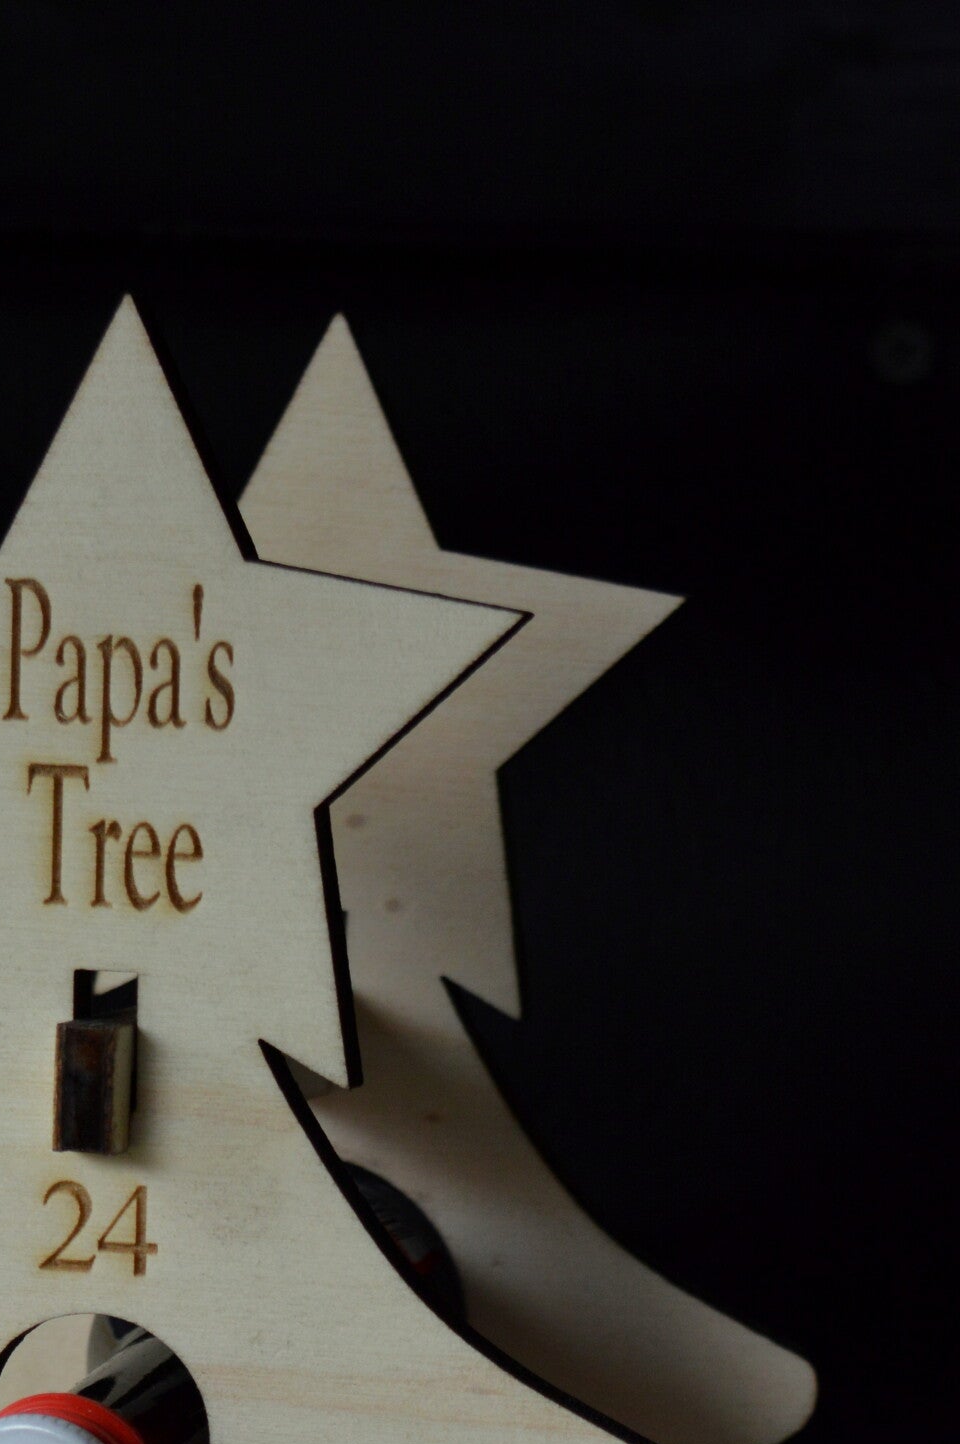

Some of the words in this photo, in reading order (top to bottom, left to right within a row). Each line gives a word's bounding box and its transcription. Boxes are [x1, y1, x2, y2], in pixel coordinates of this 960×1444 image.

[2, 576, 236, 763] Papa's
[27, 763, 204, 914] Tree
[39, 1179, 158, 1277] 24
